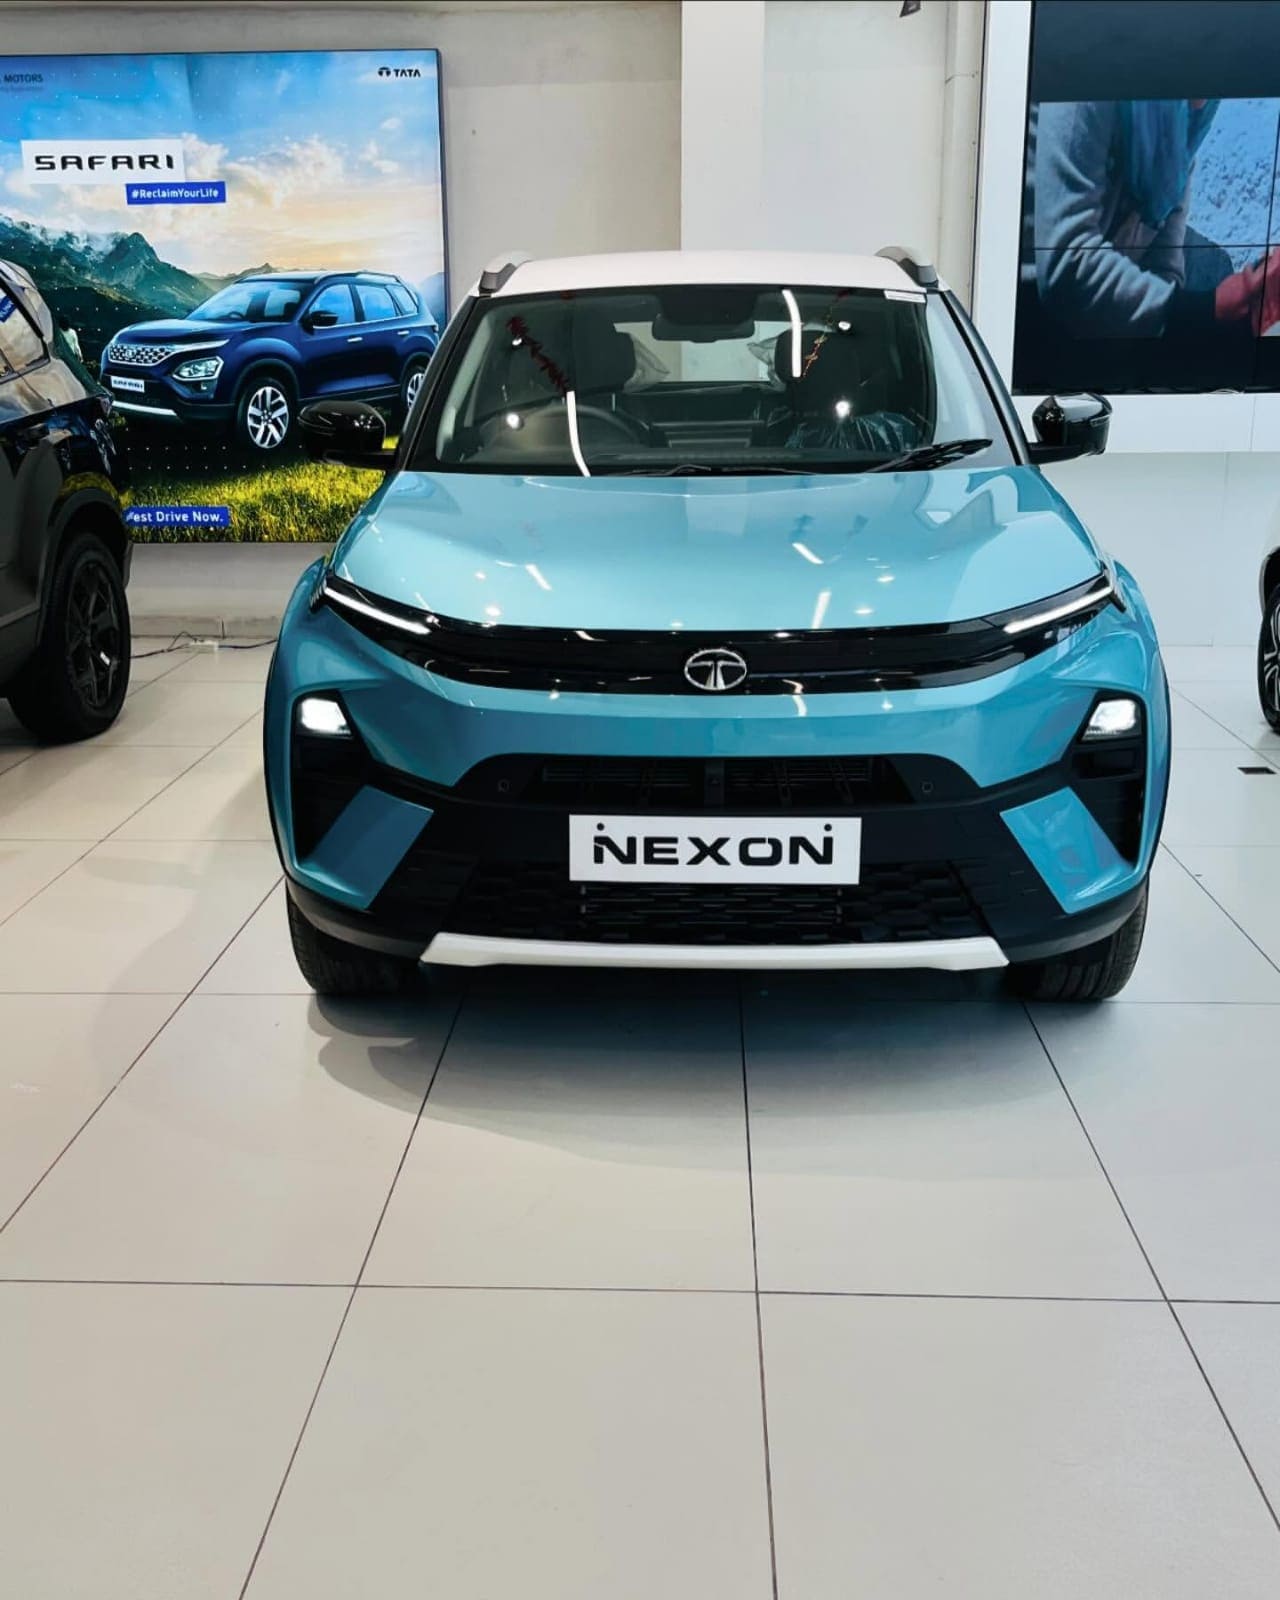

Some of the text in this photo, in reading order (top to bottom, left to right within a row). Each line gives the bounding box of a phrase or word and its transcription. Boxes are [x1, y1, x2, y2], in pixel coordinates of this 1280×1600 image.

[393, 69, 421, 78] TATA
[34, 154, 174, 171] SAFARI
[131, 187, 219, 199] #ReclaimYourLife
[156, 511, 189, 522] Drive
[192, 511, 223, 522] Now.
[593, 835, 834, 867] NEXON
